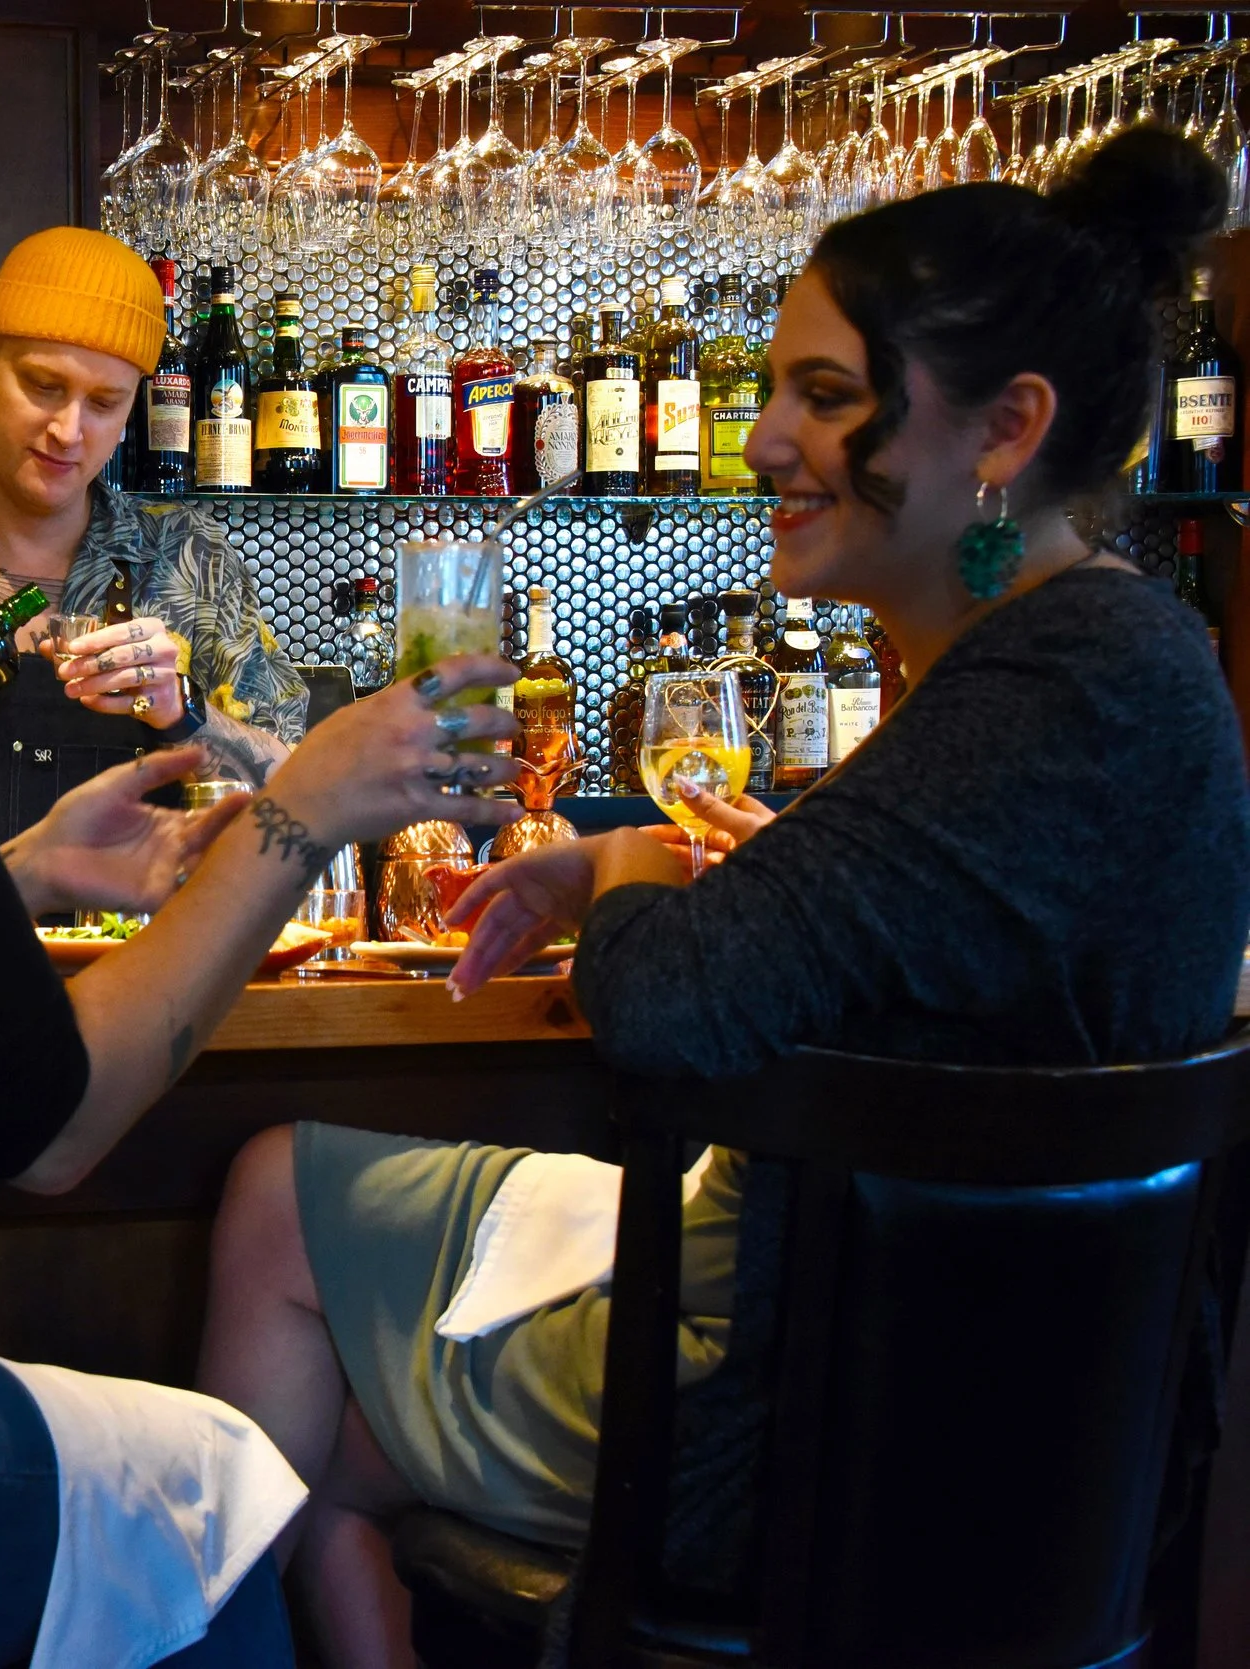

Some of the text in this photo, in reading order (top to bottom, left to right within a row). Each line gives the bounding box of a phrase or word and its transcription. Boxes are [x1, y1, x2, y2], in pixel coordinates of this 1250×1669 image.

[155, 376, 190, 386] LUXARDO
[468, 382, 514, 405] APEROL
[1179, 393, 1232, 408] BSENTE
[1192, 415, 1209, 425] 110
[514, 706, 566, 722] novo fogo
[778, 706, 795, 722] Ron
[795, 702, 807, 713] del
[34, 749, 52, 761] S&R
